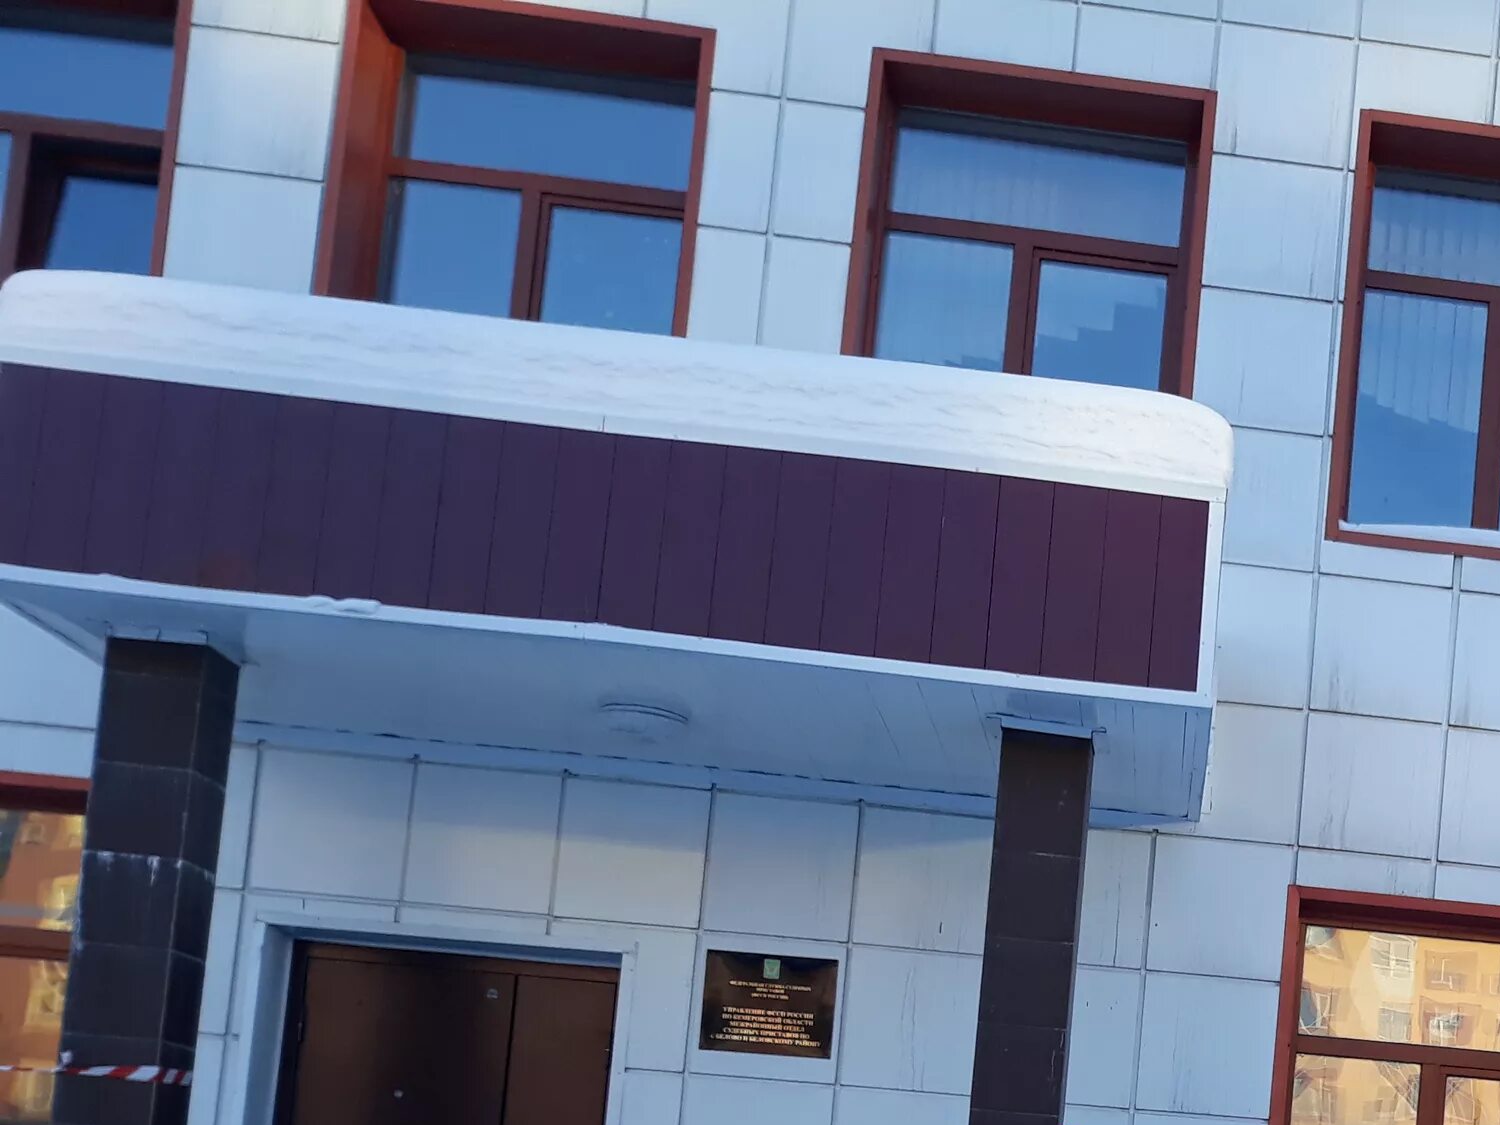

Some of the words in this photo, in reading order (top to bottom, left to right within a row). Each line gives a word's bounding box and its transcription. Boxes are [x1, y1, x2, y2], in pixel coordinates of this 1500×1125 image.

[722, 1006, 765, 1015] УПРАВЛЕНИЕ
[733, 1014, 781, 1023] КЕМЕРОВСКОЙ
[723, 1027, 759, 1035] СУДЕБНЫХ
[760, 1030, 799, 1038] ПРИСТАВОВ
